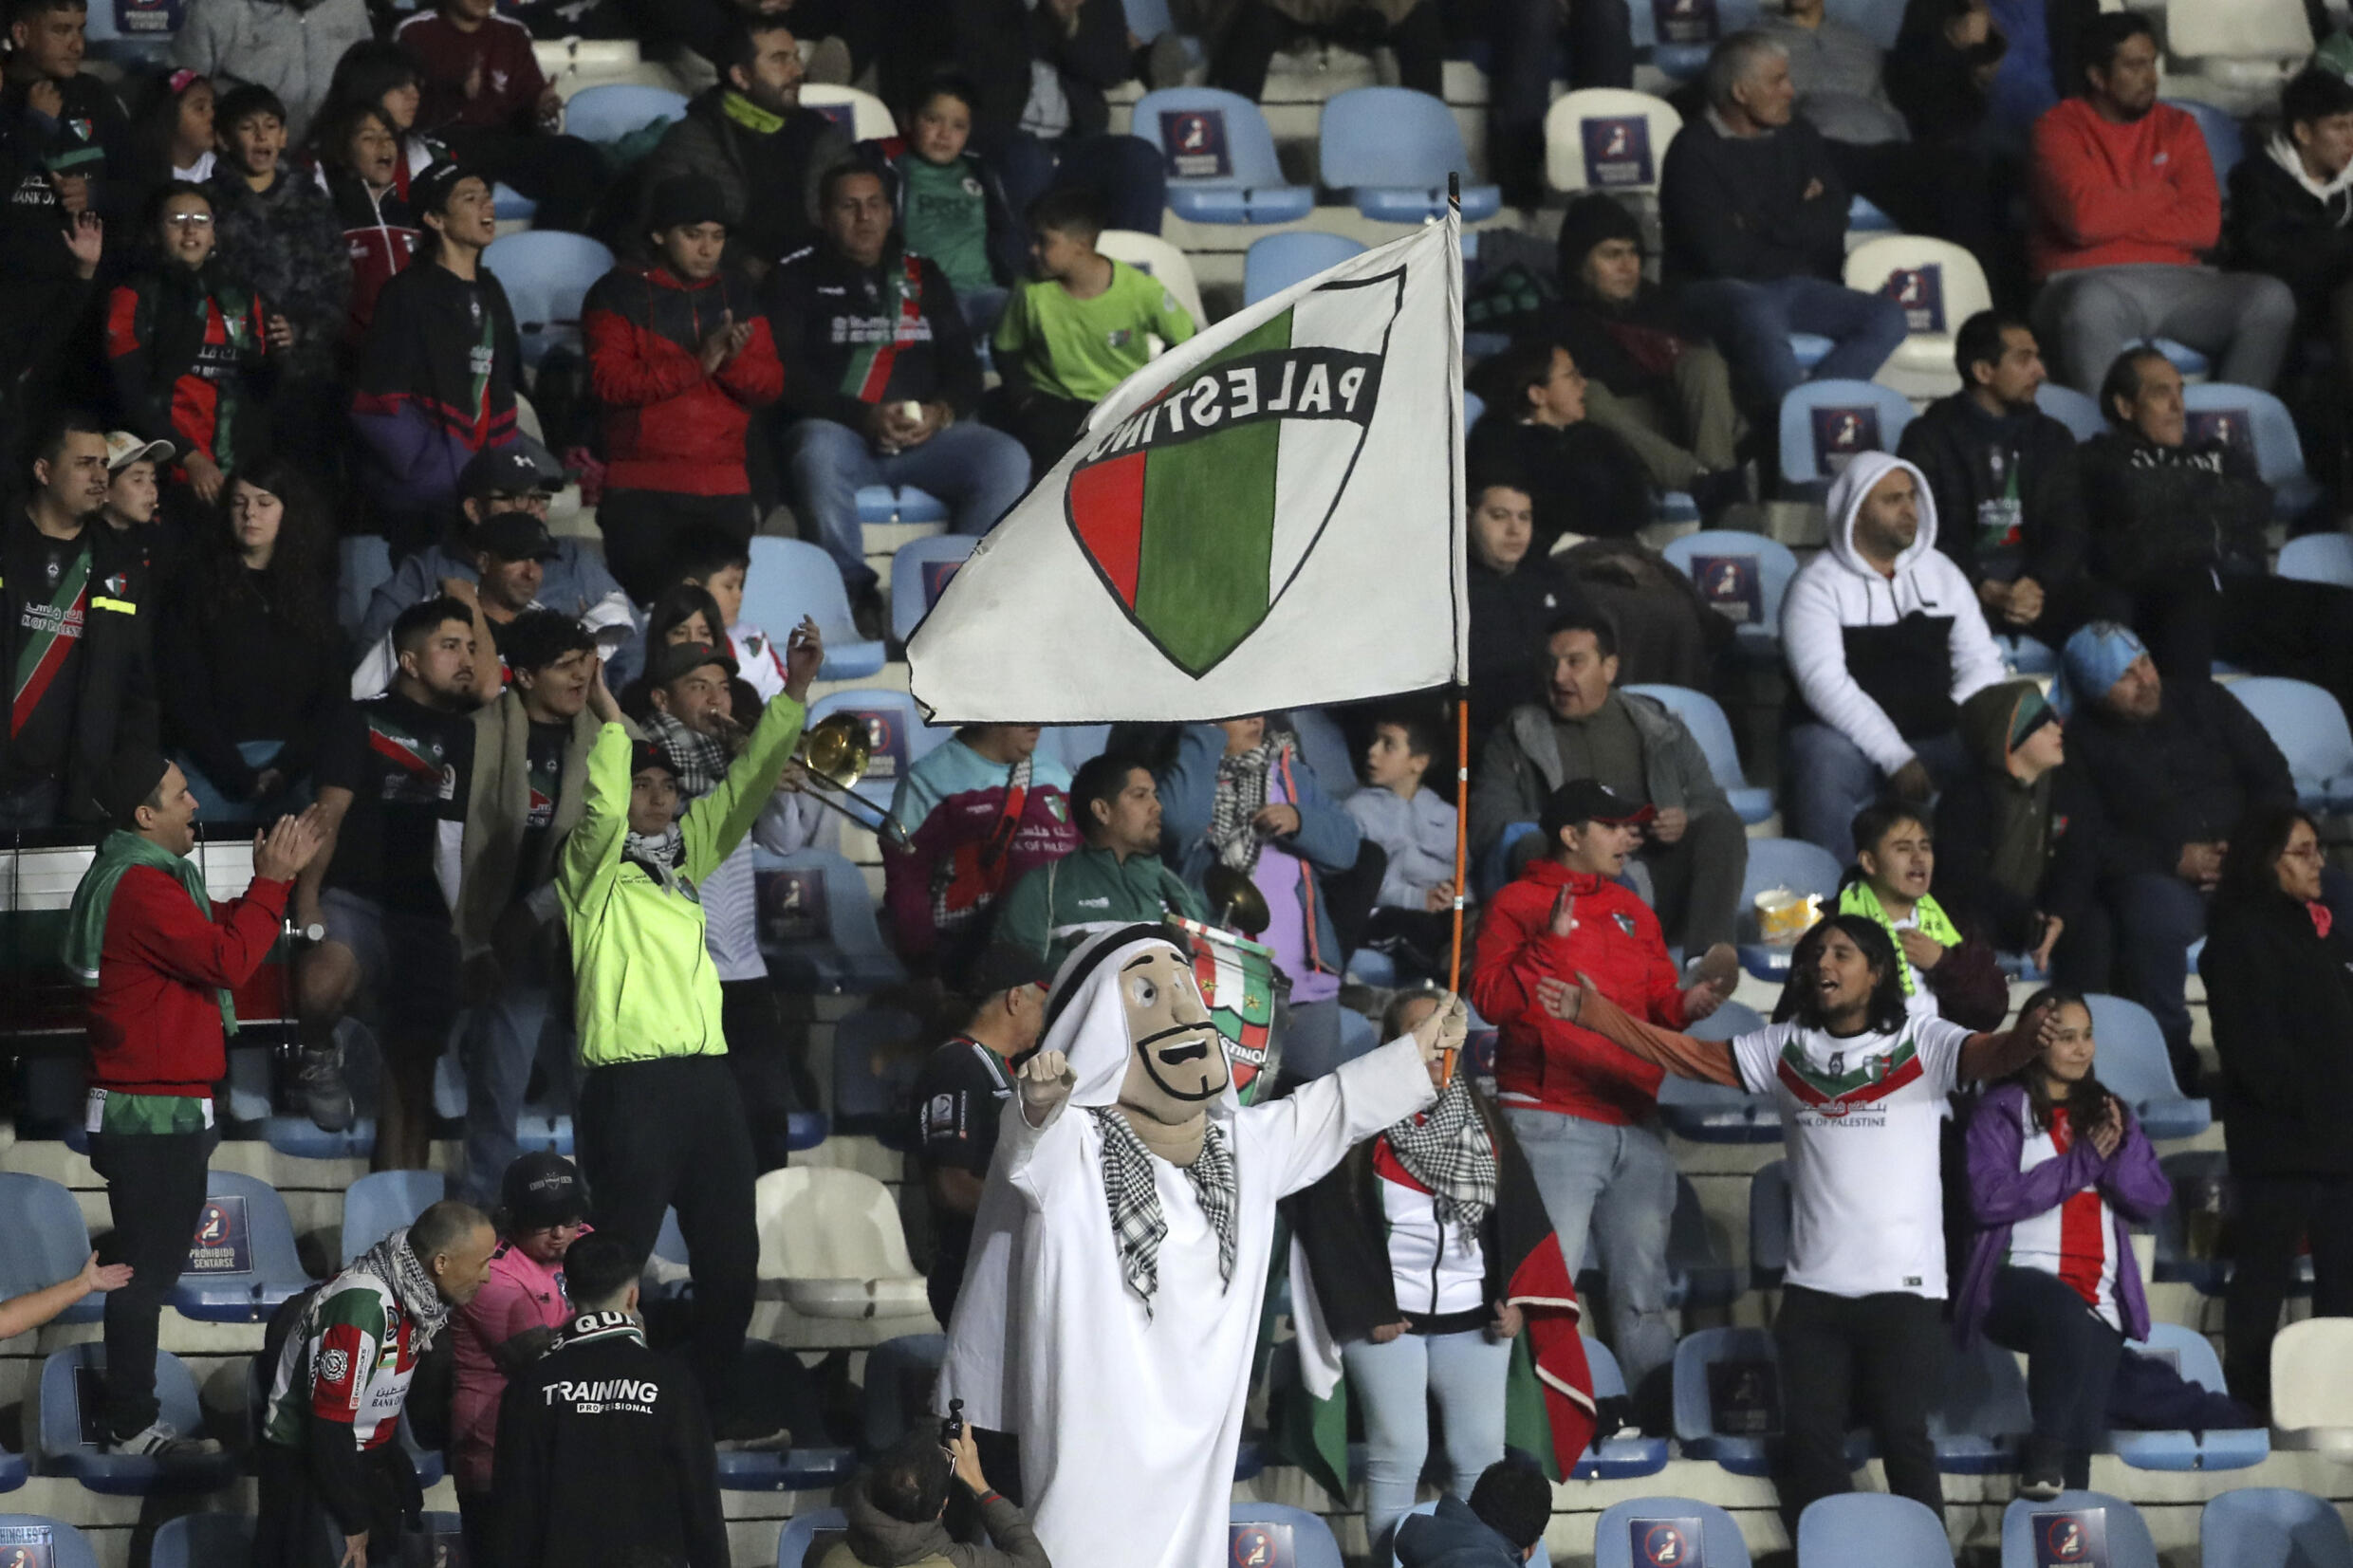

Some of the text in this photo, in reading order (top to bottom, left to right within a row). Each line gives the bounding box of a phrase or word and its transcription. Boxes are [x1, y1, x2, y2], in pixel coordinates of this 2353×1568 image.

[1831, 1116, 1886, 1128] PALESTINE
[189, 1246, 235, 1260] PROHIBIDO
[194, 1258, 235, 1269] SENTARSE
[542, 1379, 659, 1407] TRAINING
[372, 1396, 394, 1408] BANK
